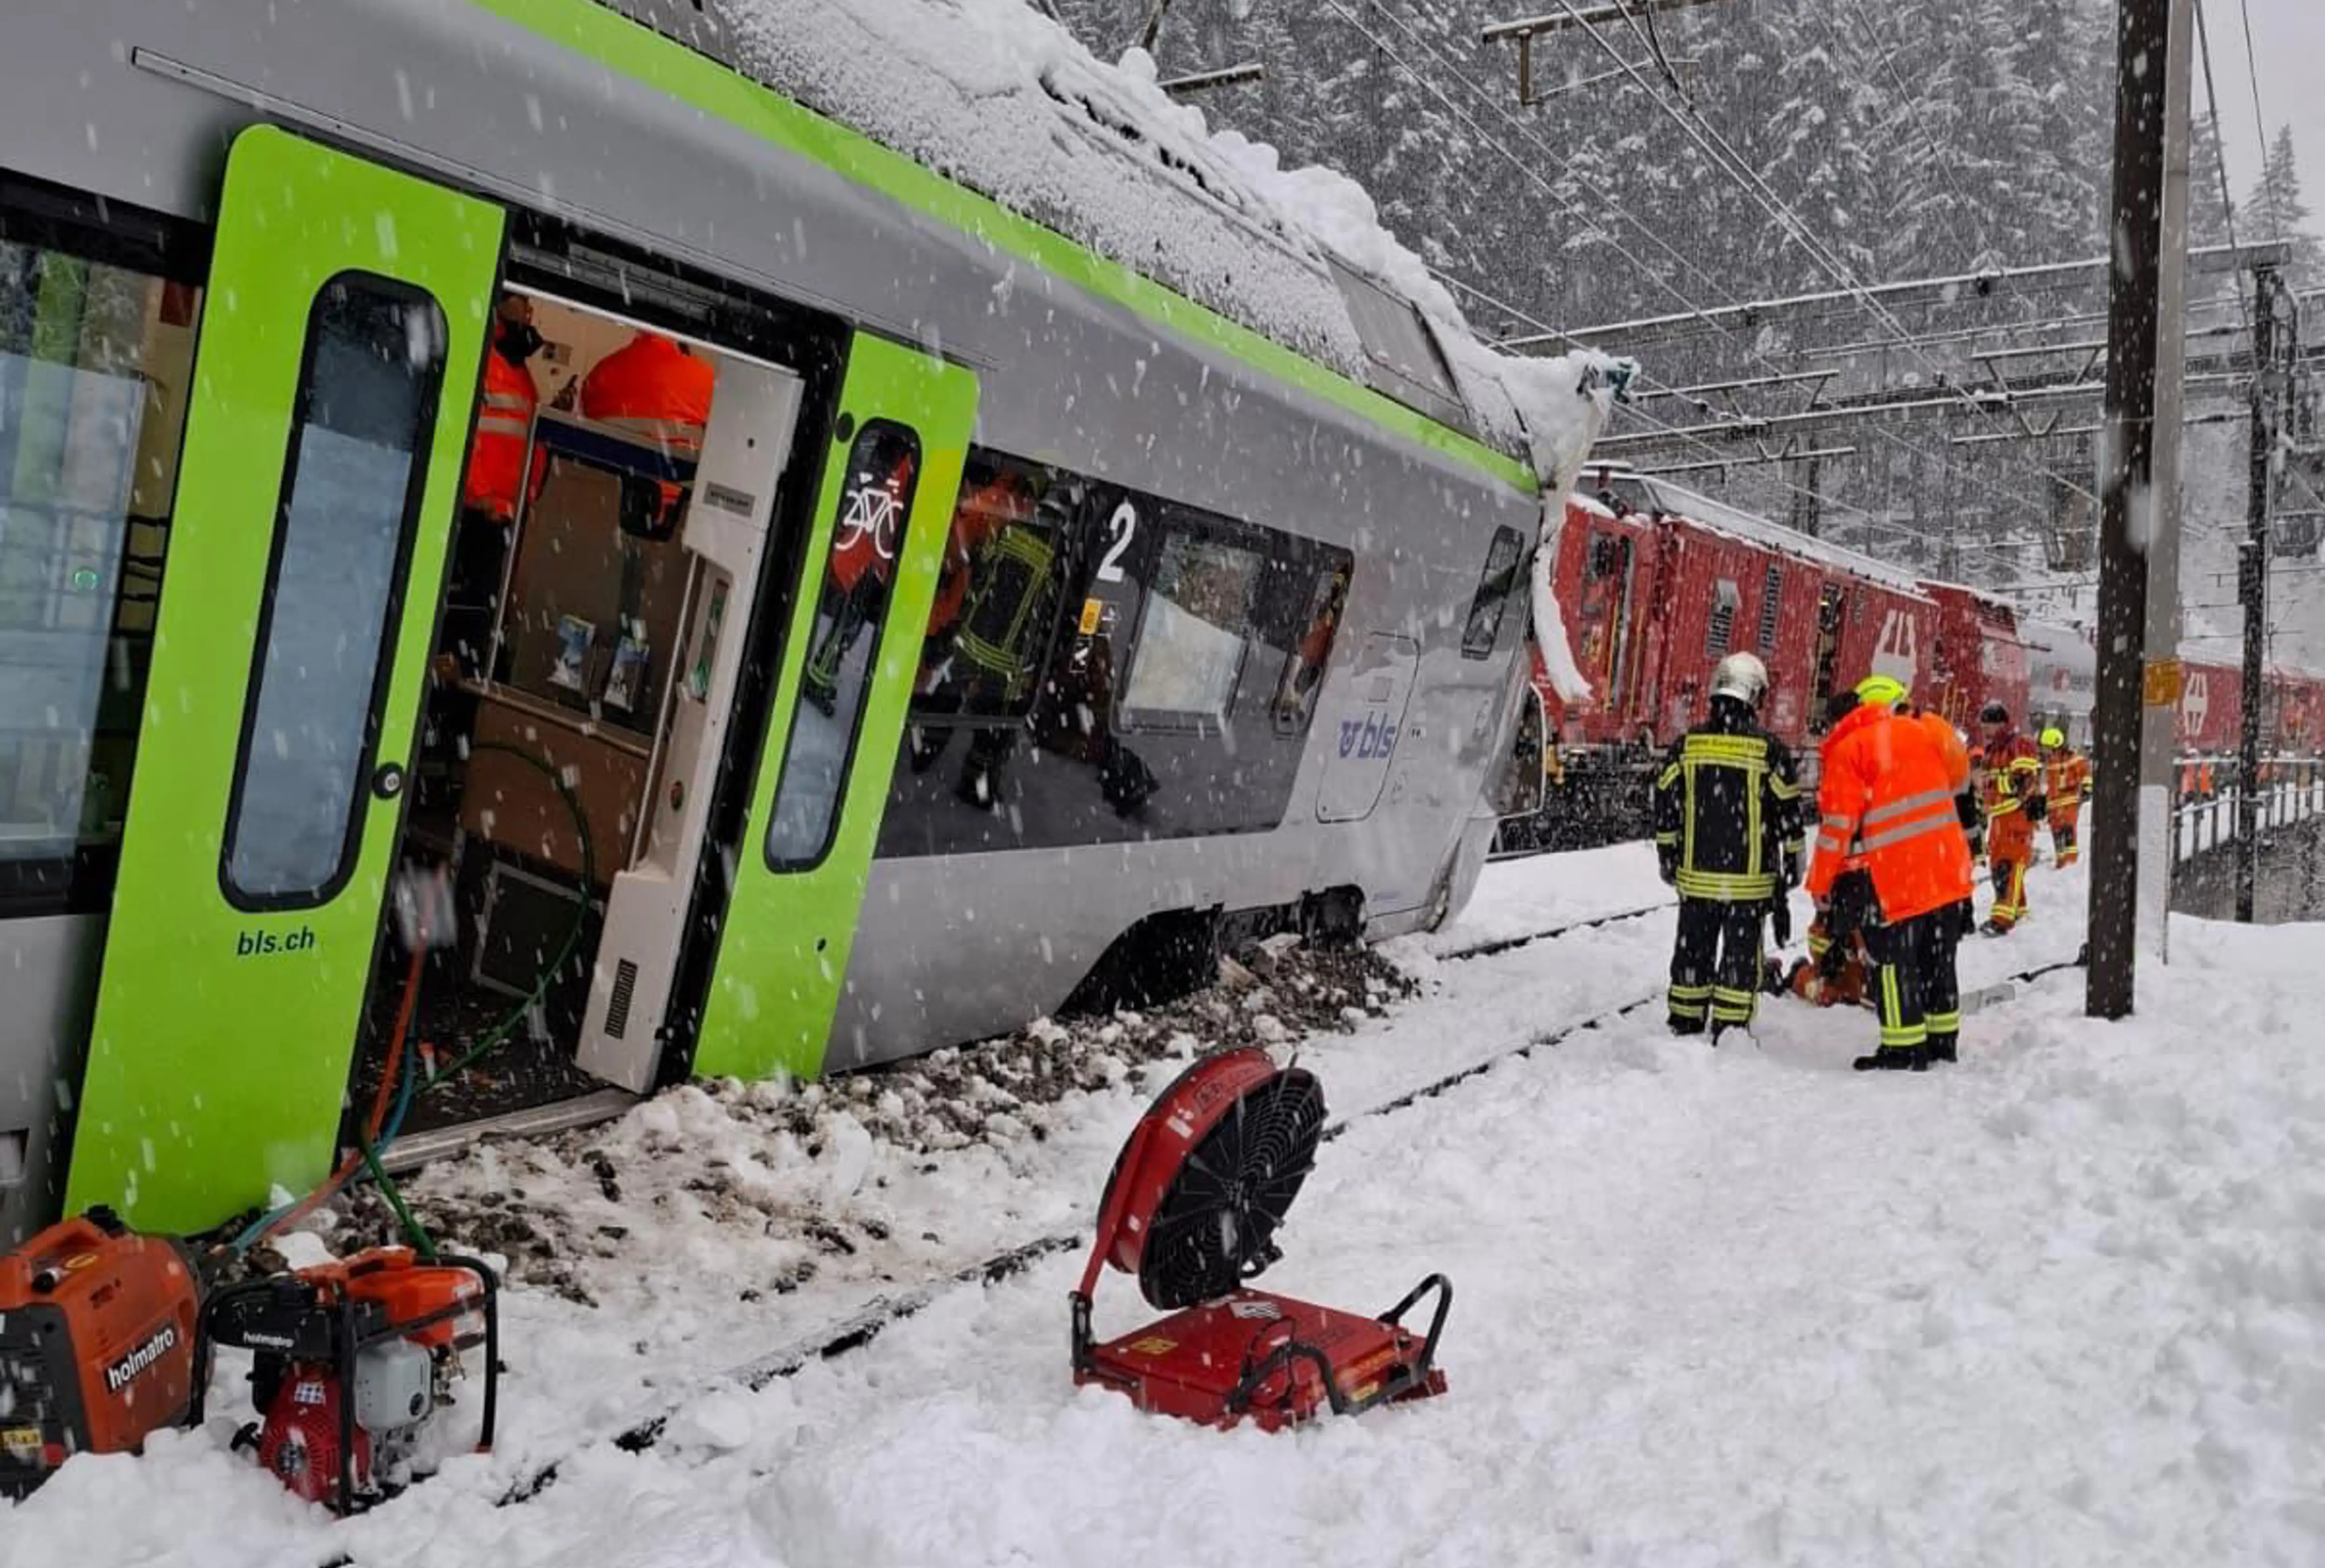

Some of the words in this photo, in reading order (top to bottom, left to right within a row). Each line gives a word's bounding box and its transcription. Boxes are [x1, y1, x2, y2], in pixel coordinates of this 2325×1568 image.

[1097, 501, 1136, 582] 2
[1358, 711, 1395, 758] bls
[237, 925, 315, 956] bls.ch
[108, 1329, 173, 1389] holmatro
